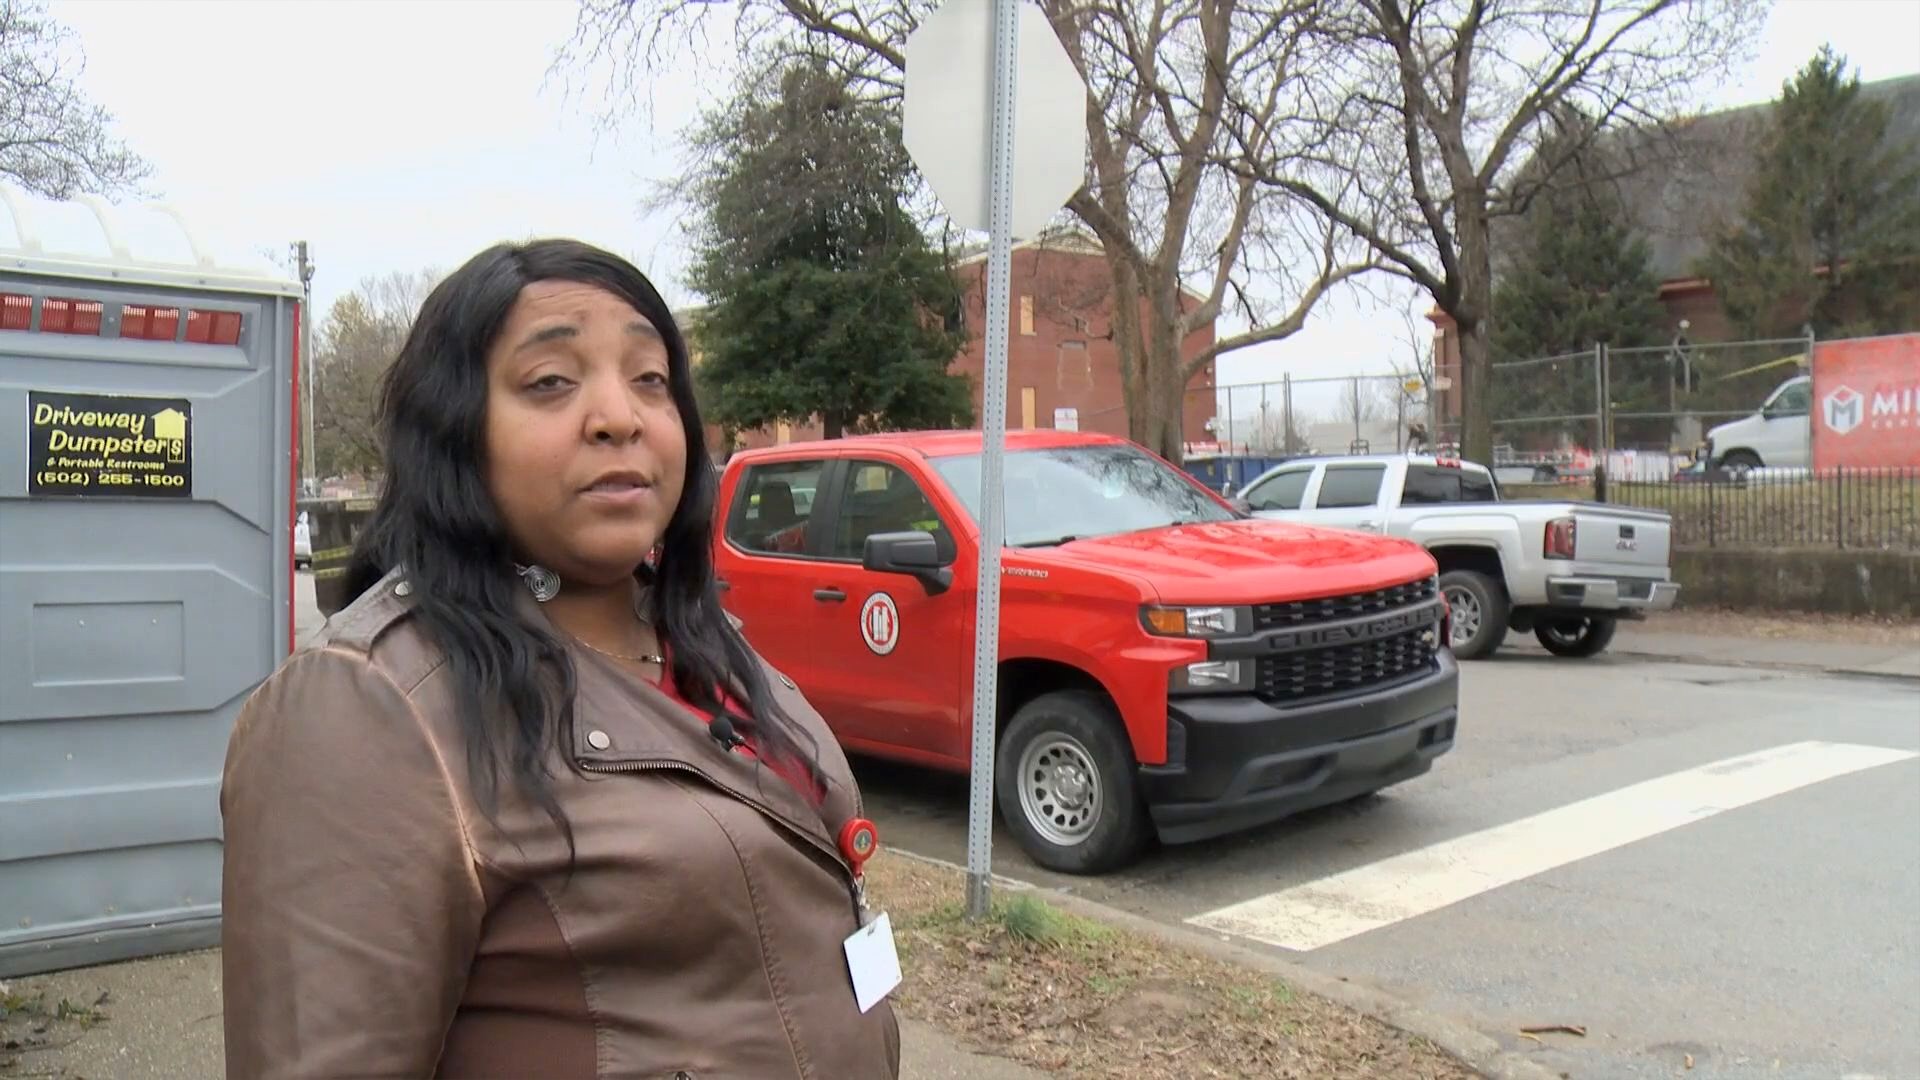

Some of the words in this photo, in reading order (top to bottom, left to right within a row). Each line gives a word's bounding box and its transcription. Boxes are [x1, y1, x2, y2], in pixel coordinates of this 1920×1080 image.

[34, 403, 146, 435] Driveway
[48, 428, 183, 458] Dumpsters
[58, 456, 104, 469] Portable
[107, 458, 165, 471] Restrooms
[36, 471, 90, 486] (502)
